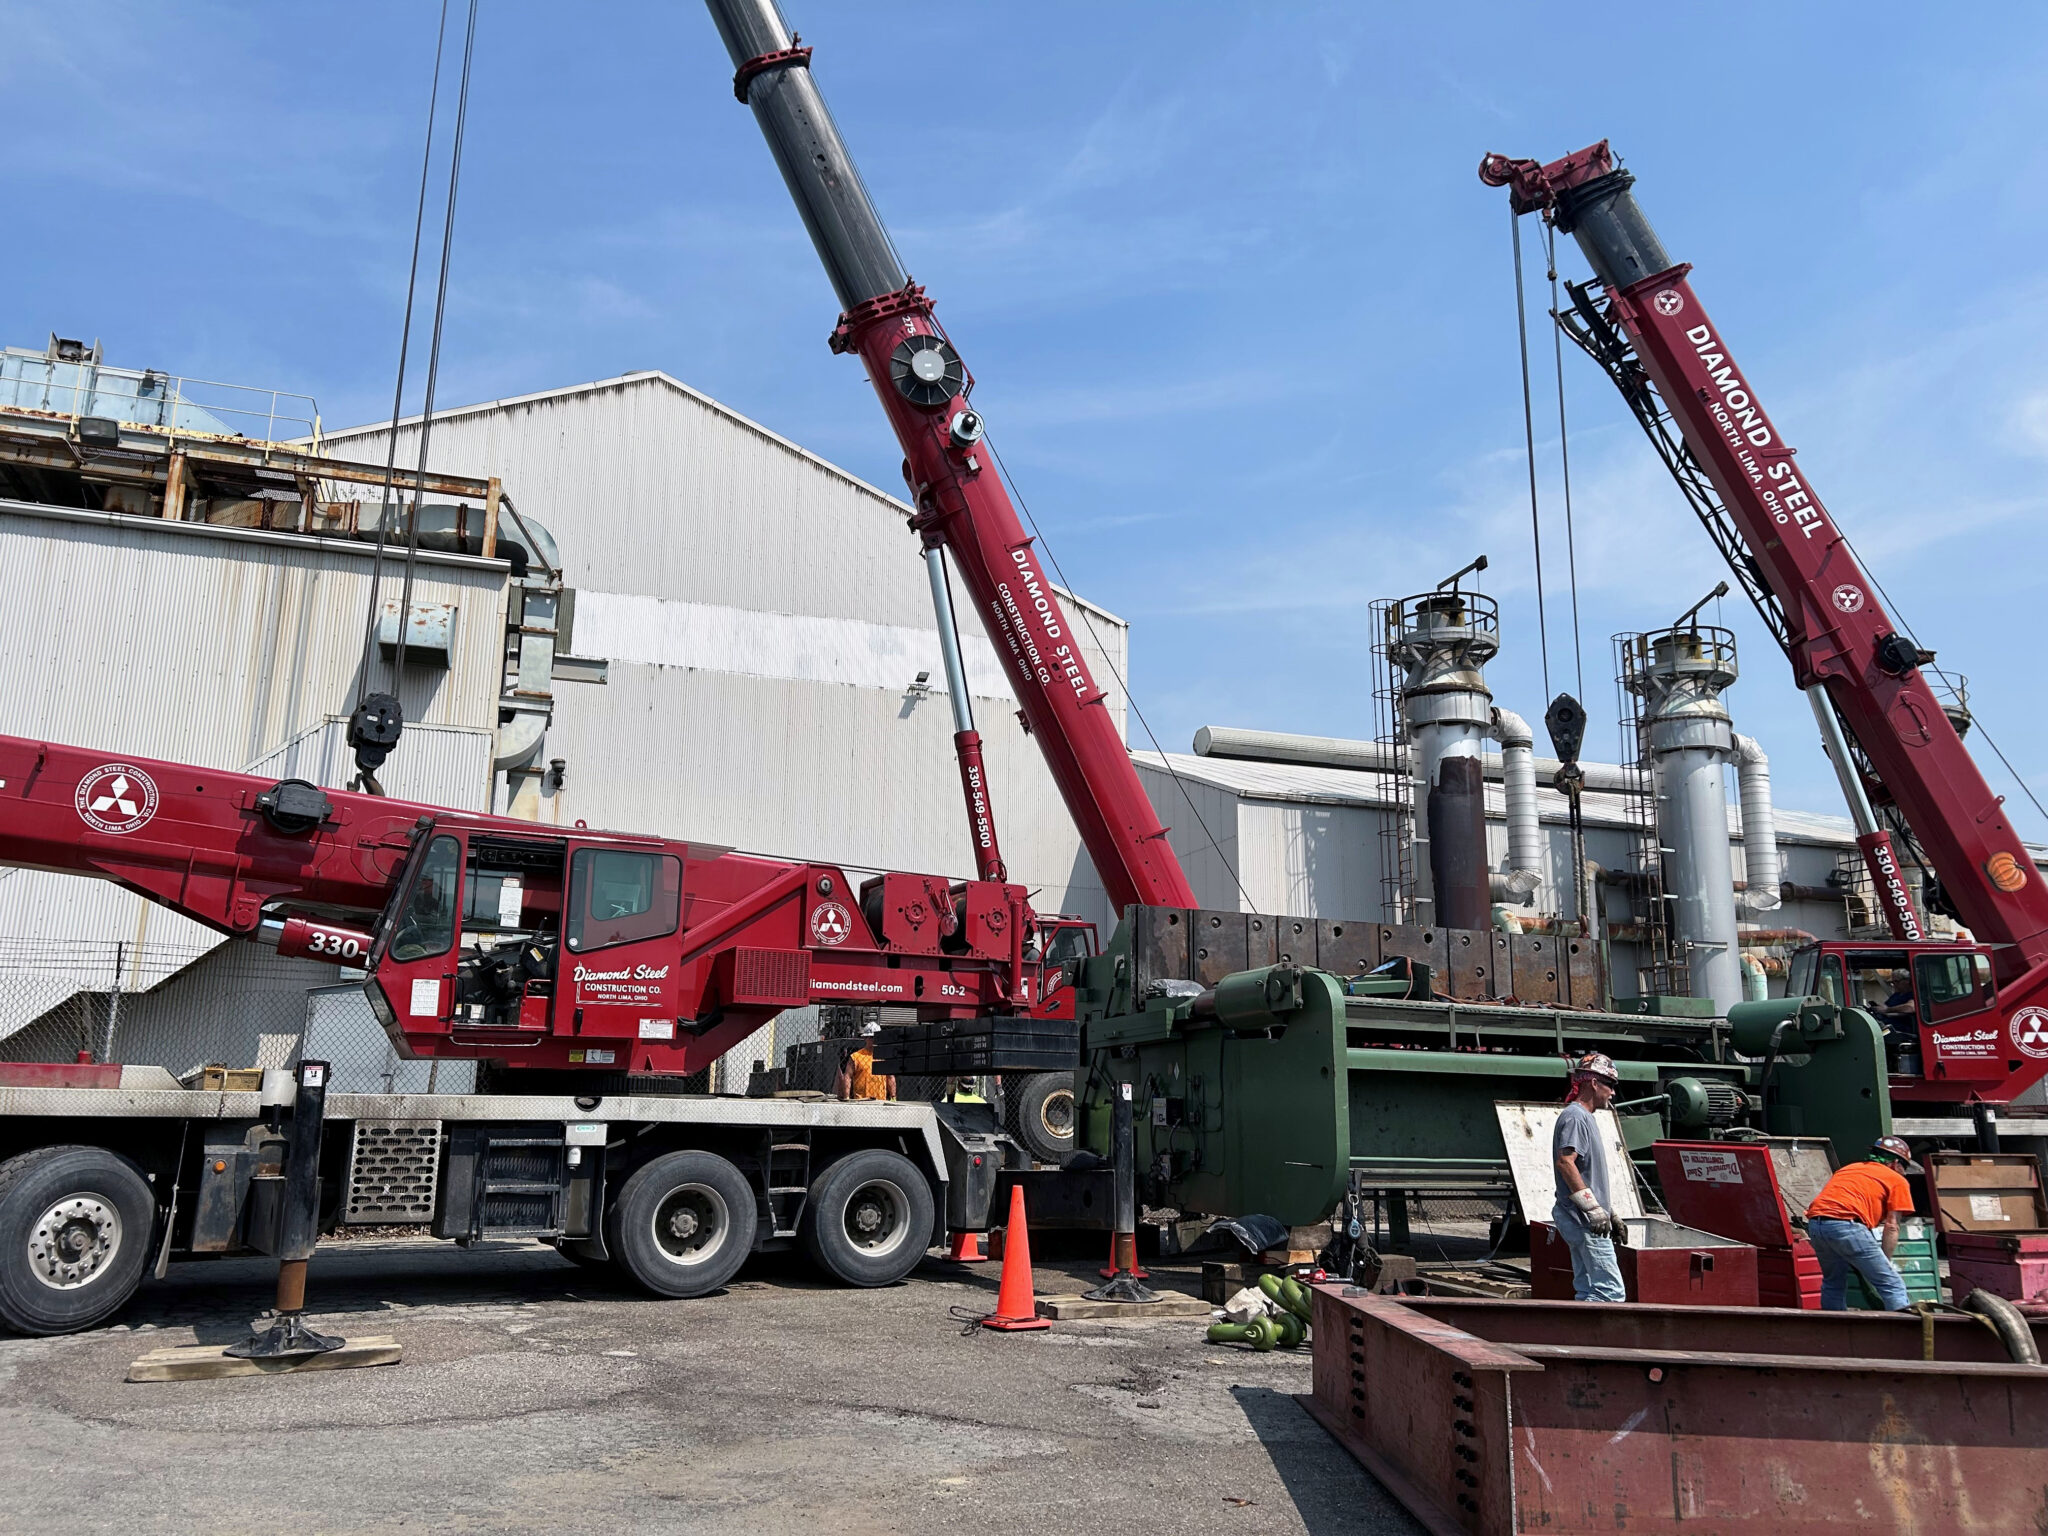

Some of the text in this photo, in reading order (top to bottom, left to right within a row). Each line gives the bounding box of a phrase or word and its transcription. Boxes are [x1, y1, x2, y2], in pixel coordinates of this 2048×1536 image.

[1686, 324, 1824, 539] DIAMOND STEEL
[1710, 402, 1744, 447] NORTH
[1763, 491, 1788, 524] OHIO
[992, 600, 1009, 631] NORTH
[1018, 659, 1032, 681] OHIO
[998, 583, 1050, 686] CONSTRUCTION CO.
[1012, 550, 1088, 698] DIAMOND STEEL
[80, 770, 102, 794] DIAMOND
[128, 769, 155, 806] CONSTRUCTION
[968, 765, 991, 848] 330-549-5500
[84, 812, 104, 828] NORTH
[126, 820, 141, 829] OHIO
[1874, 846, 1920, 940] 330-549-550
[309, 932, 367, 958] 330-
[573, 964, 669, 981] Diamond Steel
[585, 983, 661, 994] CONSTRUCTION CO.
[809, 978, 966, 996] iamondsteel.com 50-2
[1932, 1030, 1998, 1044] Diamond Steel
